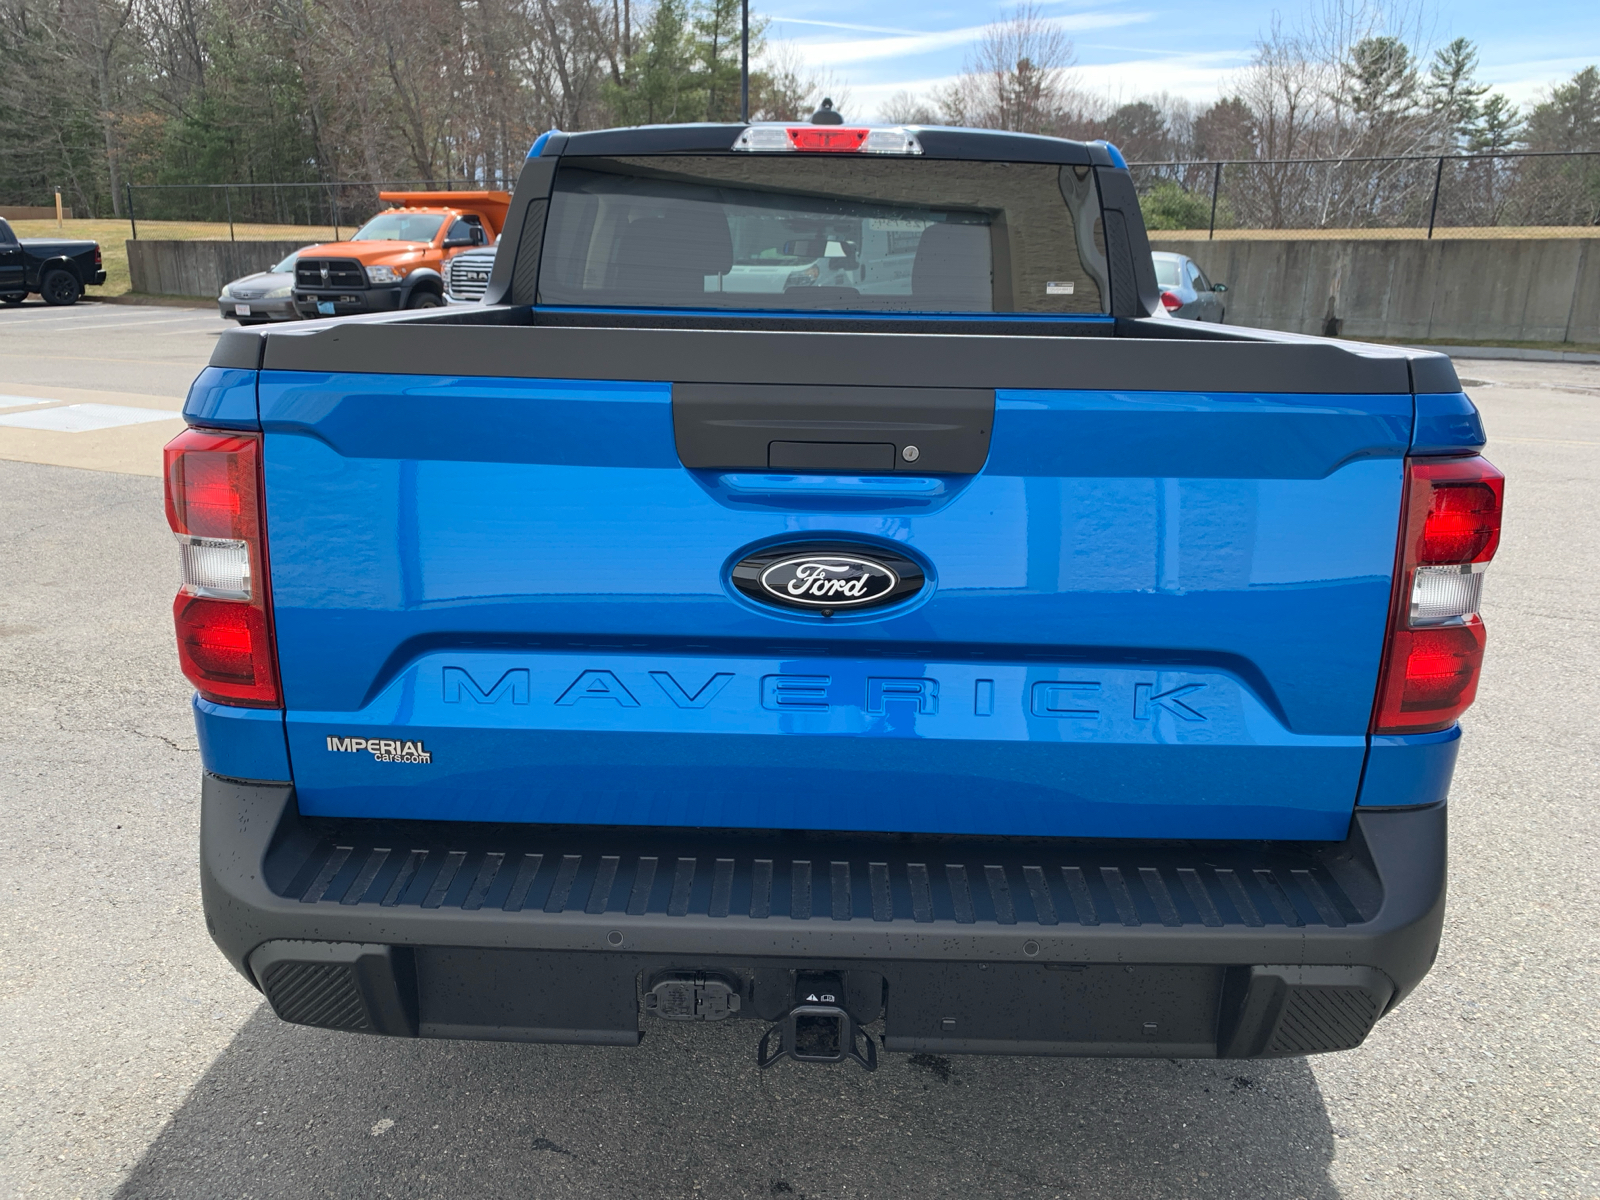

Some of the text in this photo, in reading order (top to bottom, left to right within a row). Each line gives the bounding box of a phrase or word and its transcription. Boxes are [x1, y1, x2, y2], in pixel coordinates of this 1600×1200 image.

[467, 271, 491, 280] RA
[787, 563, 869, 597] Ford
[442, 665, 1208, 722] MAVERICK
[326, 736, 431, 757] IMPERIAL
[374, 752, 432, 764] cars.com
